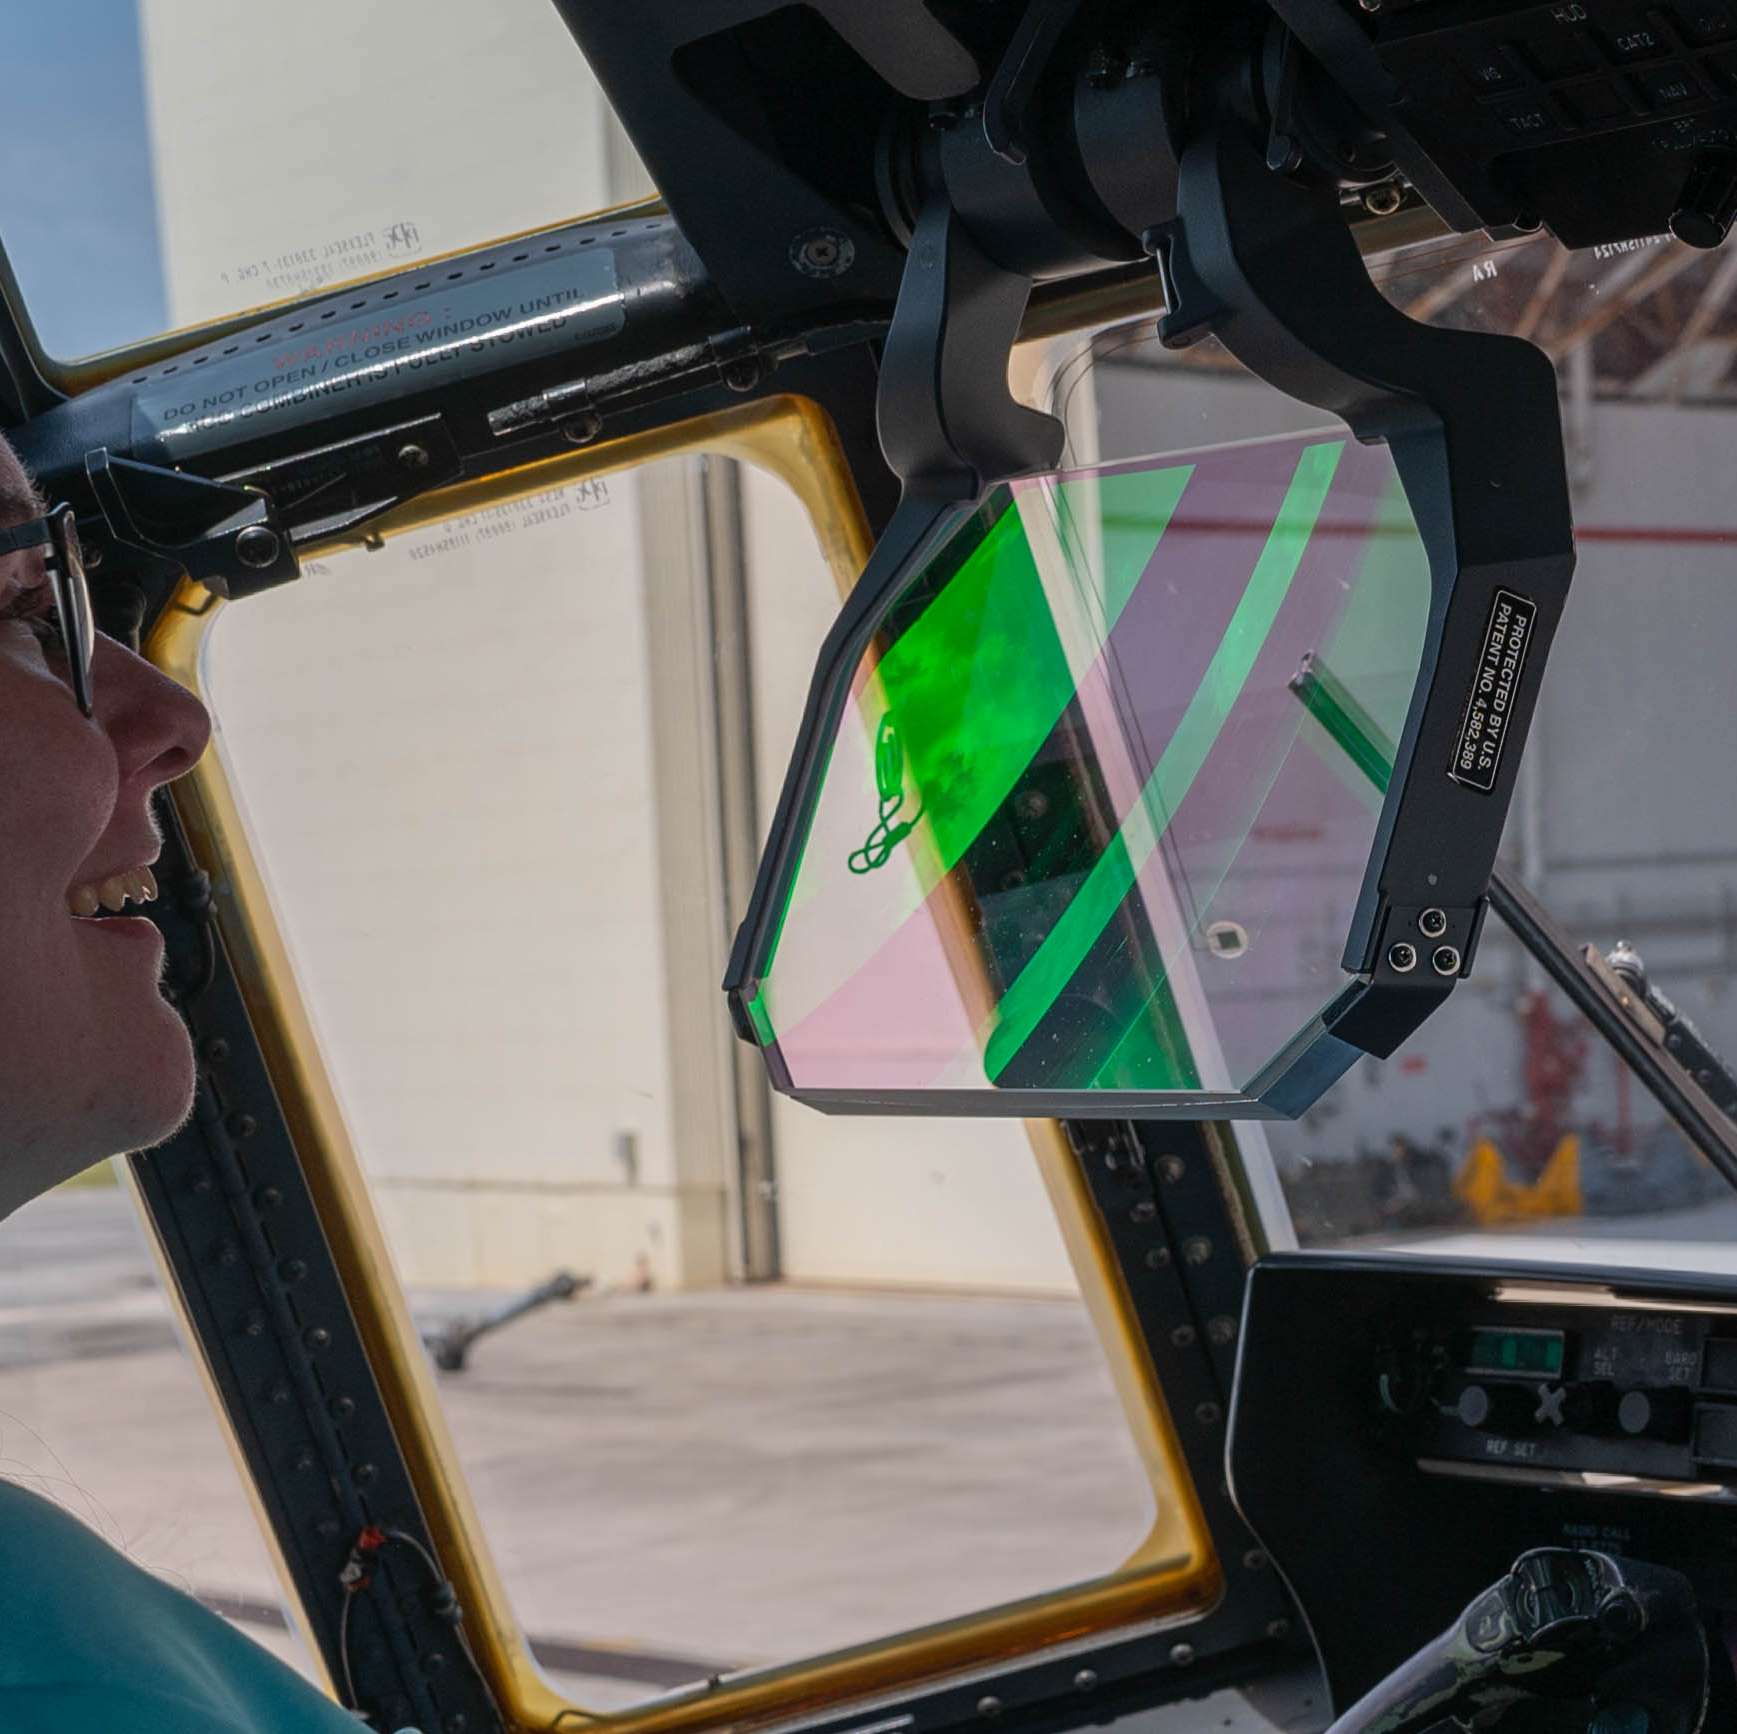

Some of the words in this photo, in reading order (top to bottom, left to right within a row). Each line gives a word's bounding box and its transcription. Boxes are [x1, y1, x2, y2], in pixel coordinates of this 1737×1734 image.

[1551, 3, 1588, 24] HUD
[1615, 31, 1656, 51] CAT2
[164, 404, 195, 421] DO
[203, 386, 248, 409] NOT
[254, 365, 316, 393] OPEN
[334, 336, 411, 368] CLOSE
[415, 306, 512, 345] WINDOW
[519, 287, 586, 314] UNTIL
[272, 310, 432, 371] WARNING
[1486, 602, 1512, 663] PATENT
[1477, 668, 1497, 695] NO.
[1491, 613, 1527, 713] PROTECTED
[1459, 698, 1488, 770] 4,582,389
[1488, 715, 1503, 740] BY
[1477, 742, 1497, 771] U.S.
